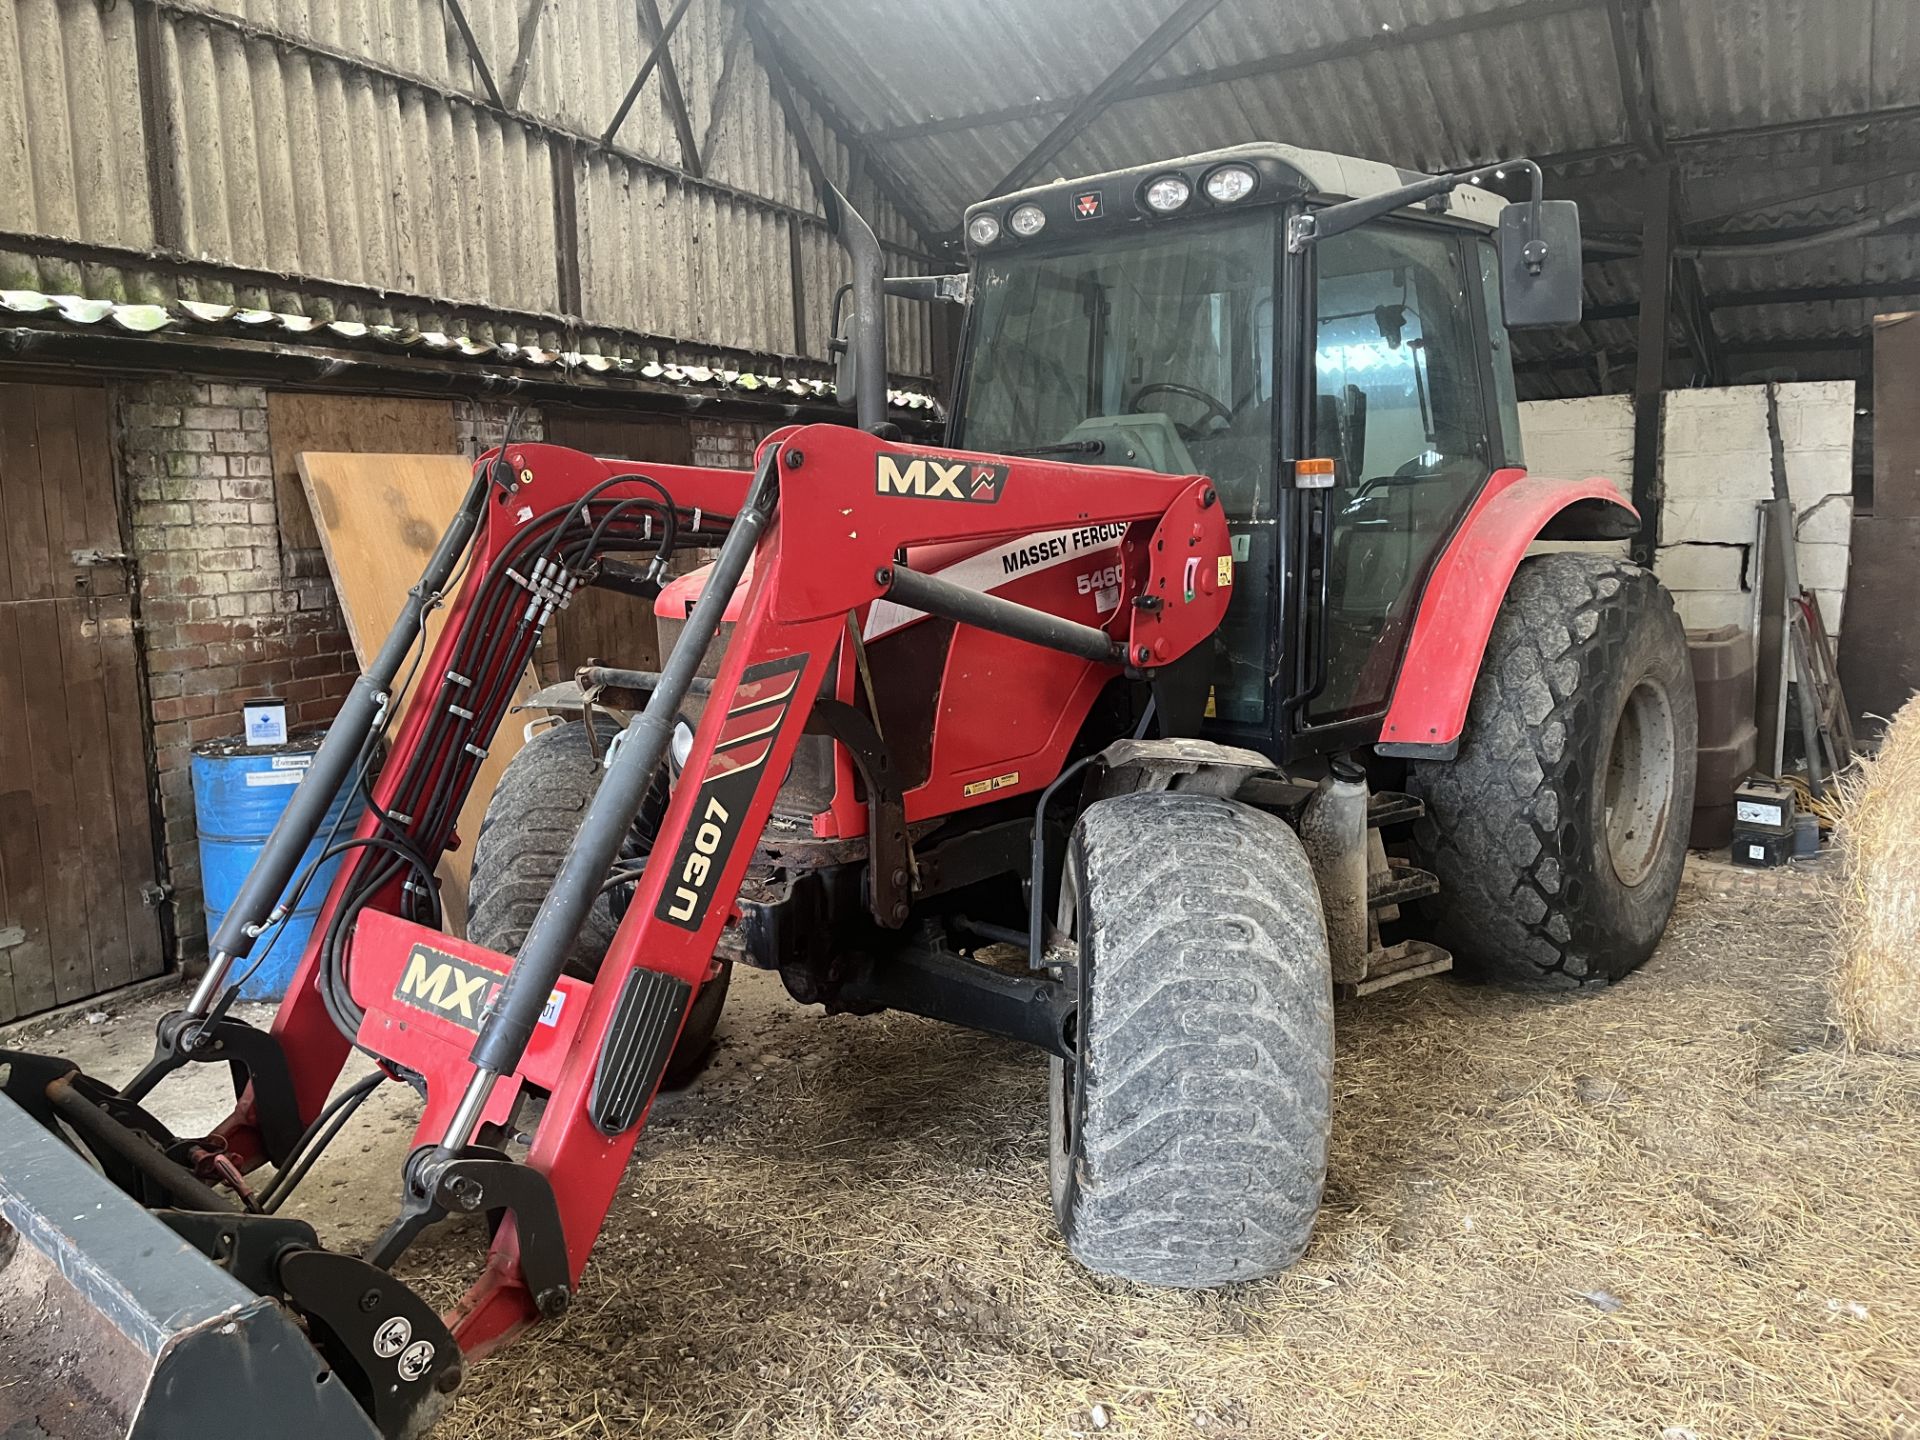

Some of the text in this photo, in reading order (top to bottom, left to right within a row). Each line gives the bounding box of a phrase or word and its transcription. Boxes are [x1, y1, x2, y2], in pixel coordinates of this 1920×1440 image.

[877, 456, 966, 499] MX
[1002, 522, 1129, 574] MASSEY FERGUS
[400, 953, 489, 1020] MX
